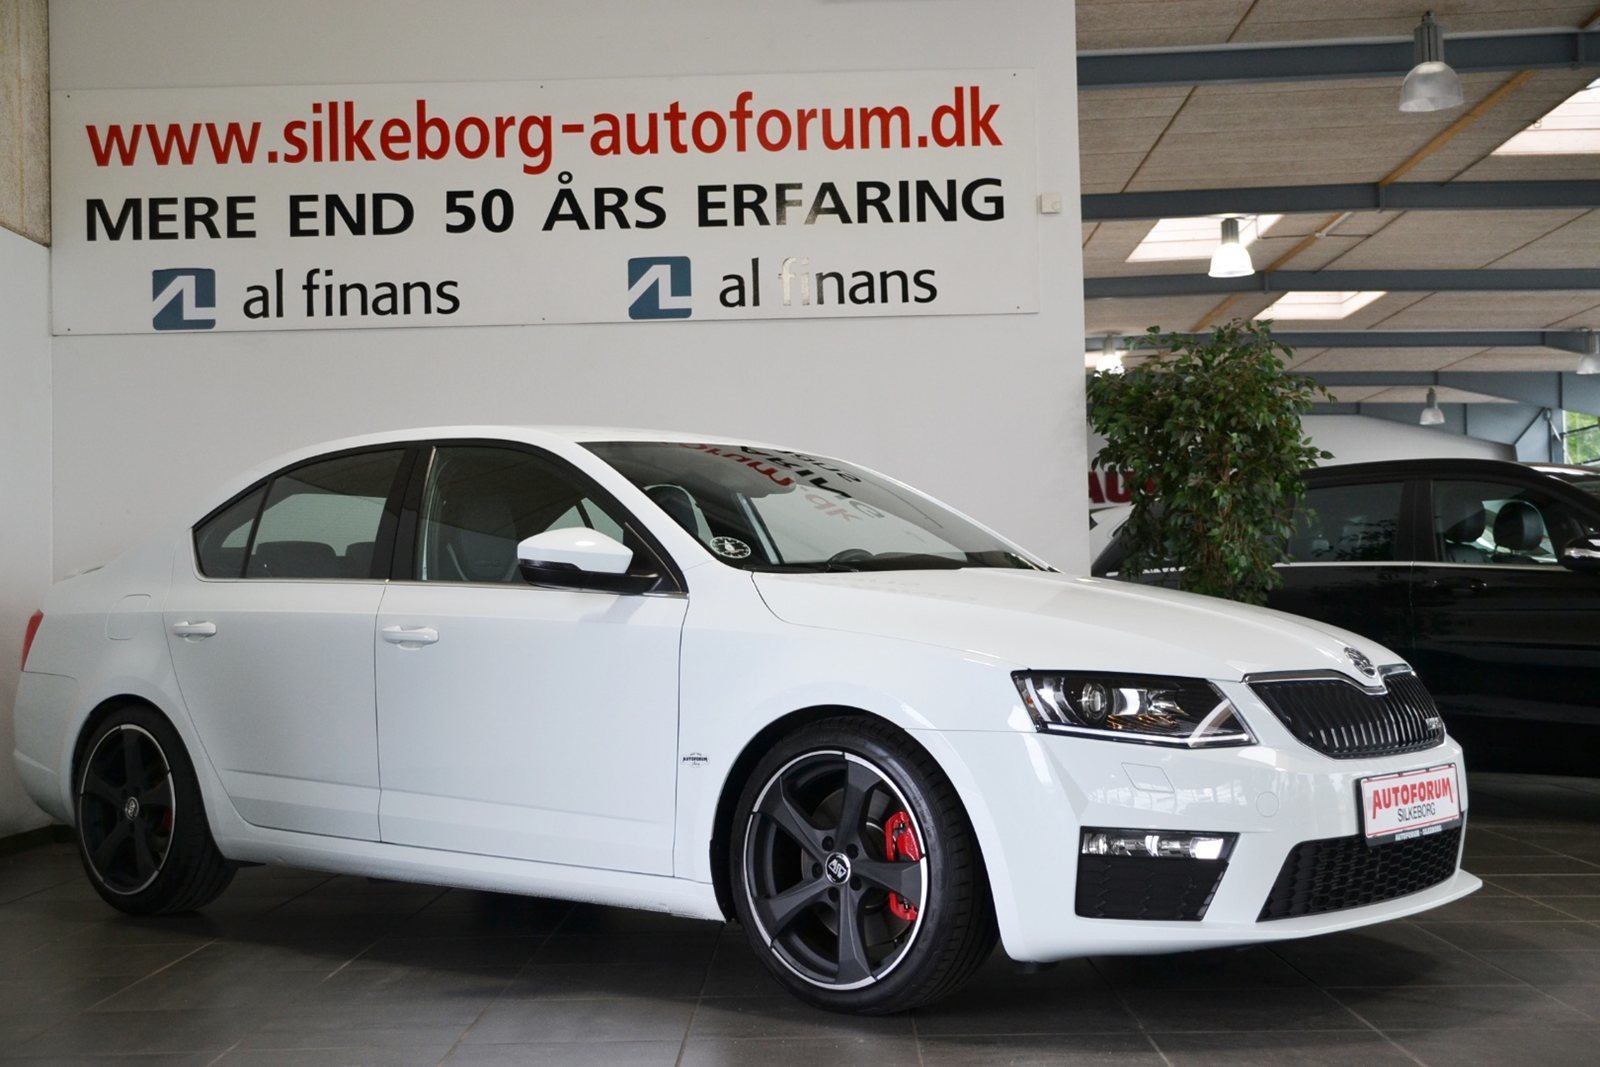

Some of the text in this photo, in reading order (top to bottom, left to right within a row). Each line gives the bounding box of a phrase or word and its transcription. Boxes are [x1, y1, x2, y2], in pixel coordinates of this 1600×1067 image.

[86, 85, 1003, 175] www.silkeborg-autoforum.dk
[86, 171, 1005, 242] MERE END 50 ÅRS ERFARING
[243, 267, 460, 319] al finans
[719, 255, 938, 308] al finans
[1372, 776, 1454, 820] AUTOFORUM
[1397, 802, 1436, 823] SILKEBORG
